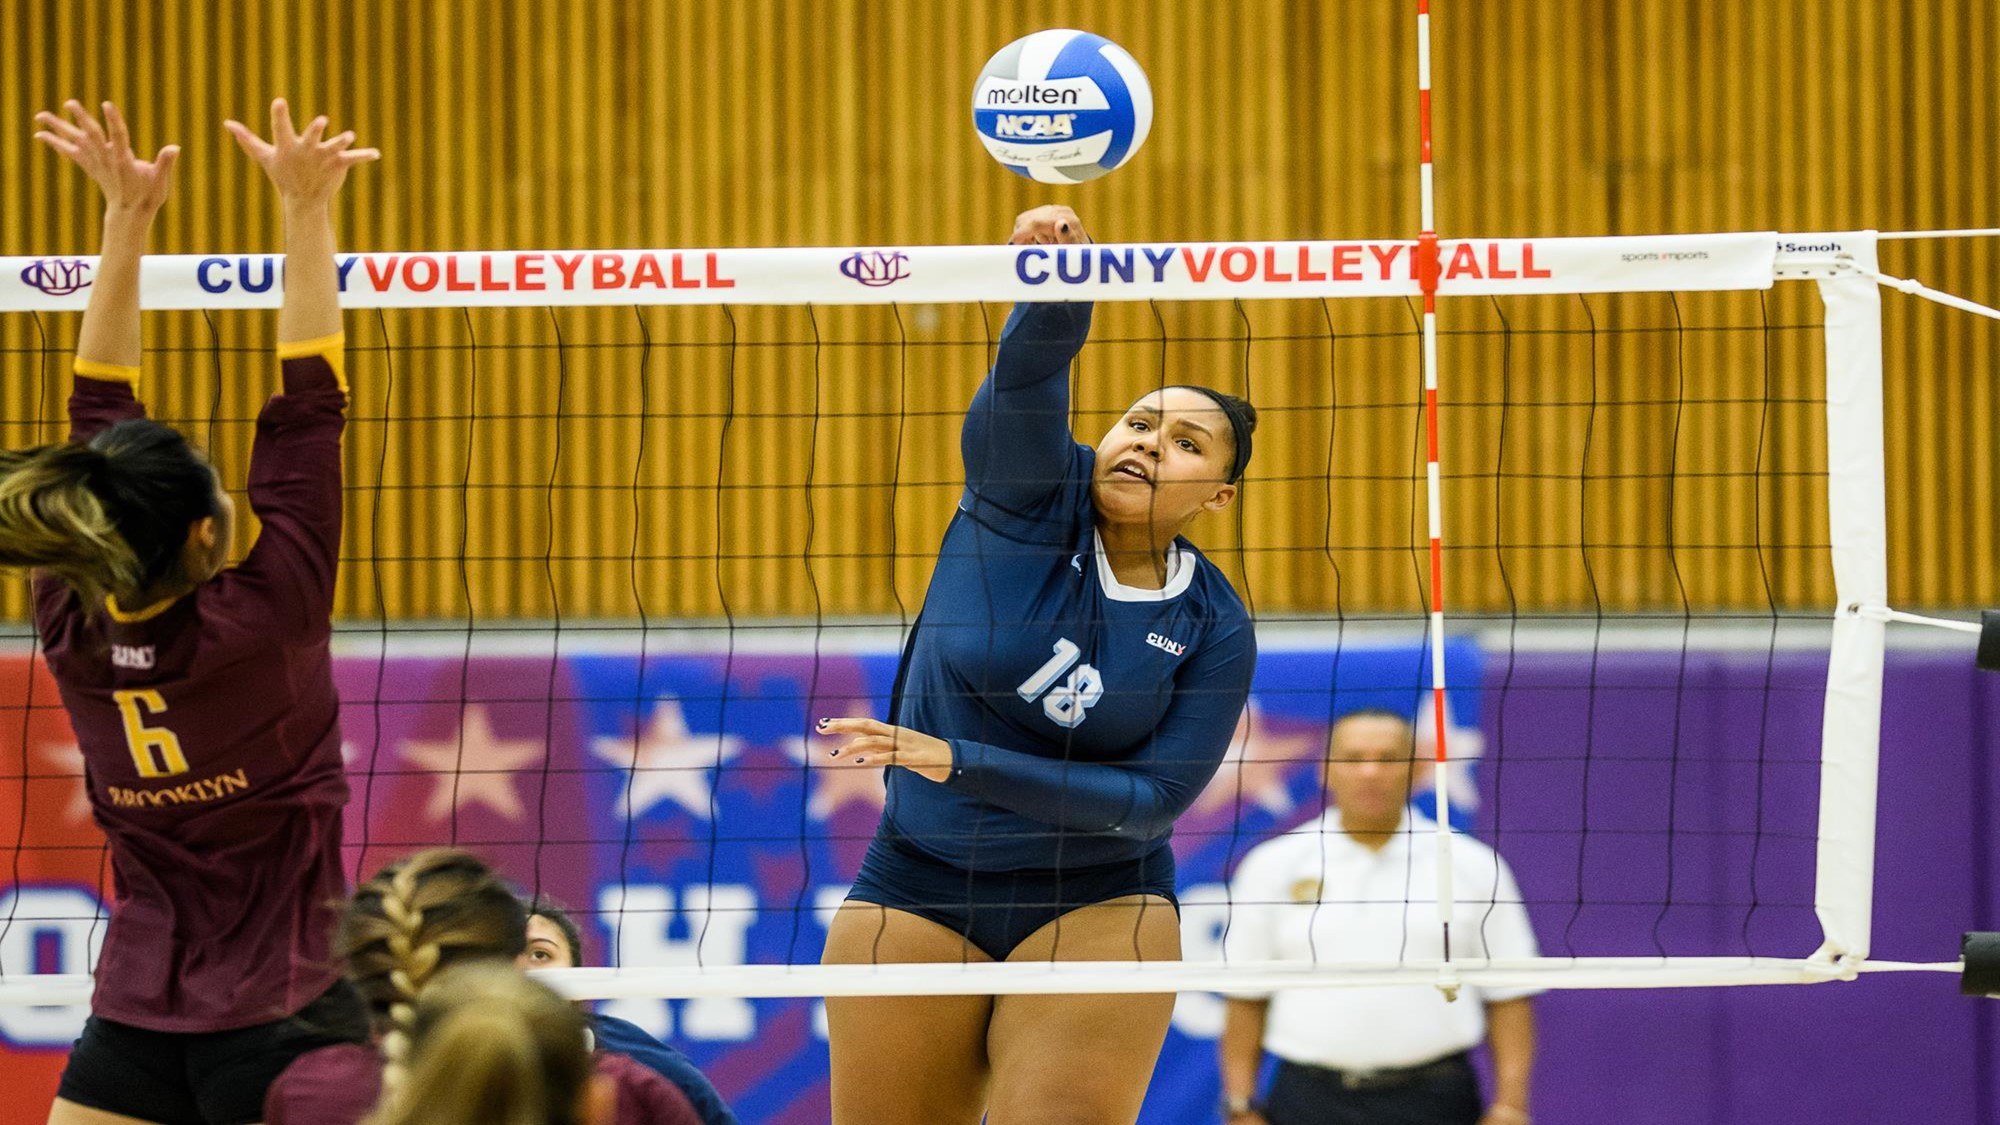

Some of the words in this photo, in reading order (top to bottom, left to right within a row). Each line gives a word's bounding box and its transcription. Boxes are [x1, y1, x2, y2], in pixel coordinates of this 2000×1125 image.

[987, 85, 1077, 105] molten
[995, 113, 1073, 138] NCAA
[1785, 242, 1841, 252] Senoh
[1145, 632, 1187, 657] CUNY
[1016, 637, 1104, 729] 18
[112, 689, 190, 778] 6
[108, 768, 249, 807] BROOKLYN
